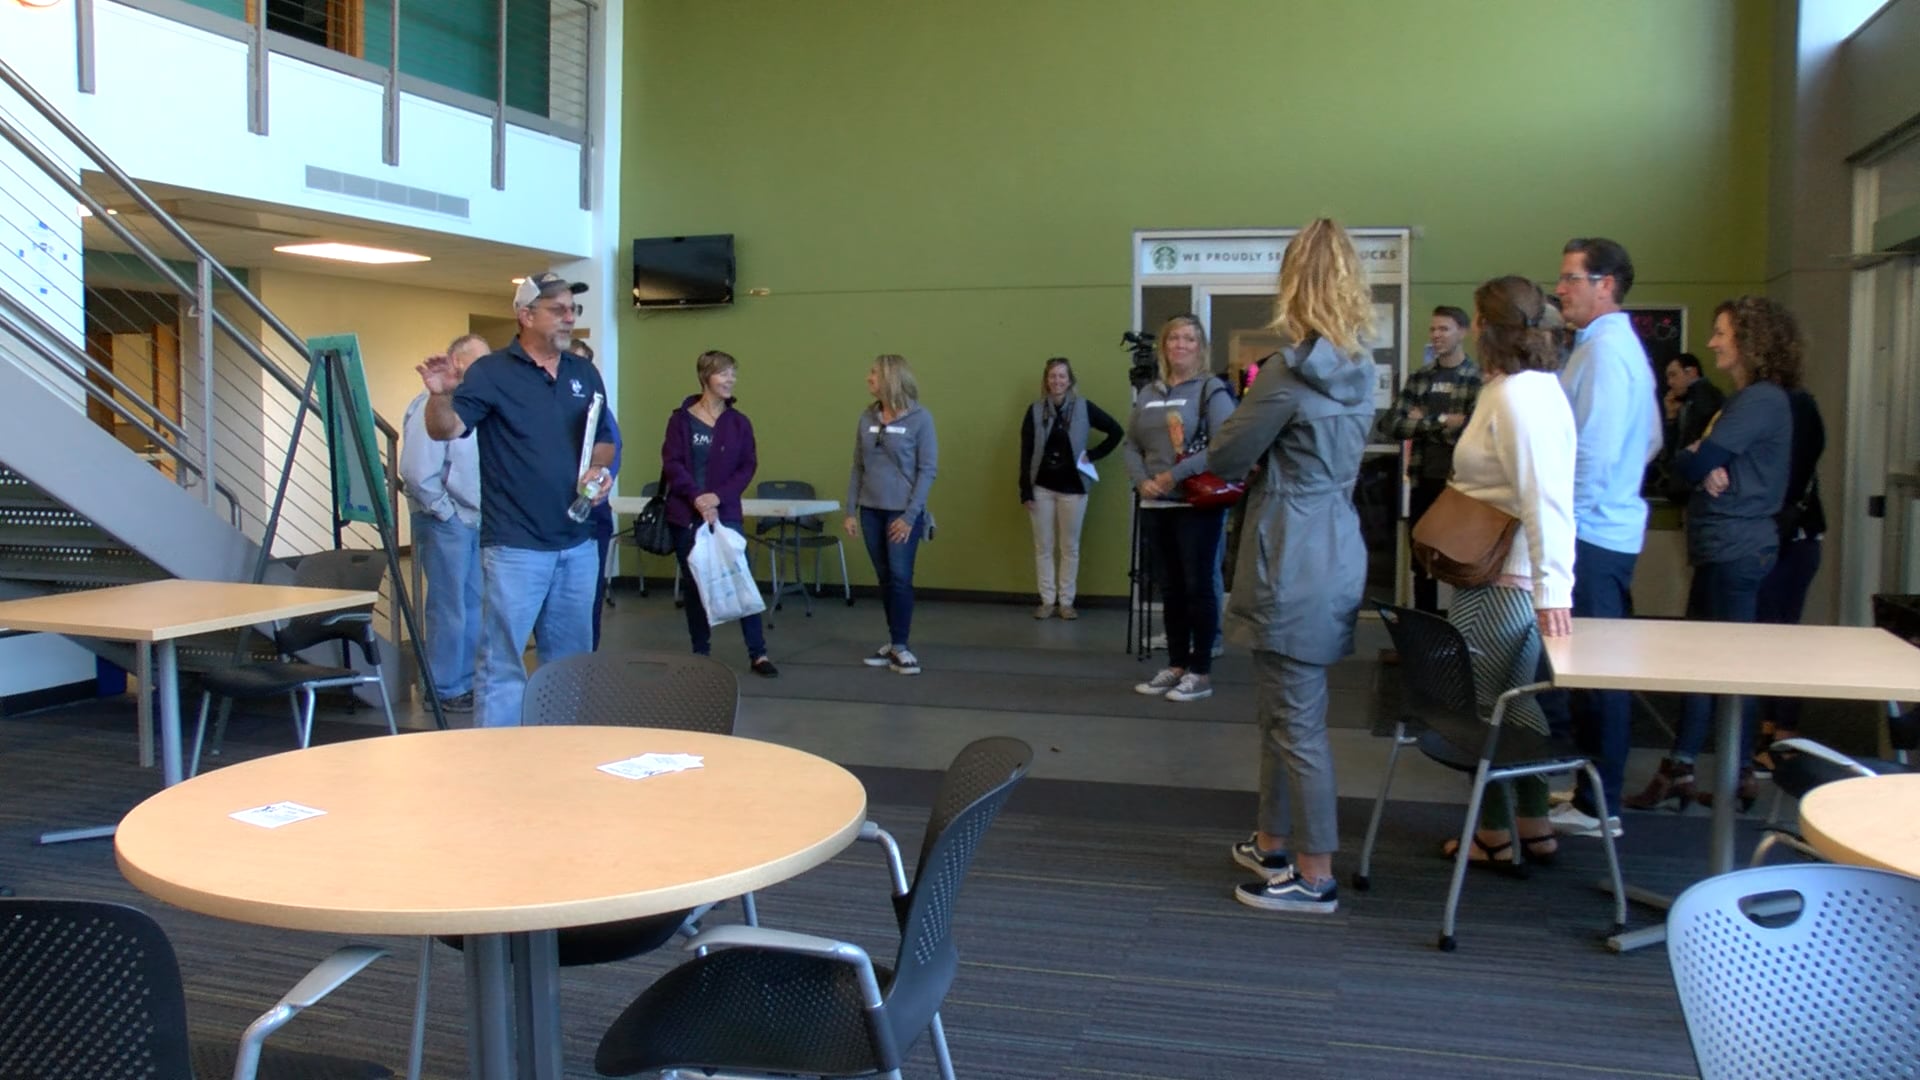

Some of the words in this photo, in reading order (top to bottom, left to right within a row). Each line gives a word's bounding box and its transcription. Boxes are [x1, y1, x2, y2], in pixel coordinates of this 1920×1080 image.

[1183, 252, 1200, 262] WE
[1206, 252, 1262, 262] PROUDLY
[1268, 252, 1281, 261] SE
[1360, 250, 1397, 260] UCKS
[693, 433, 712, 445] SM
